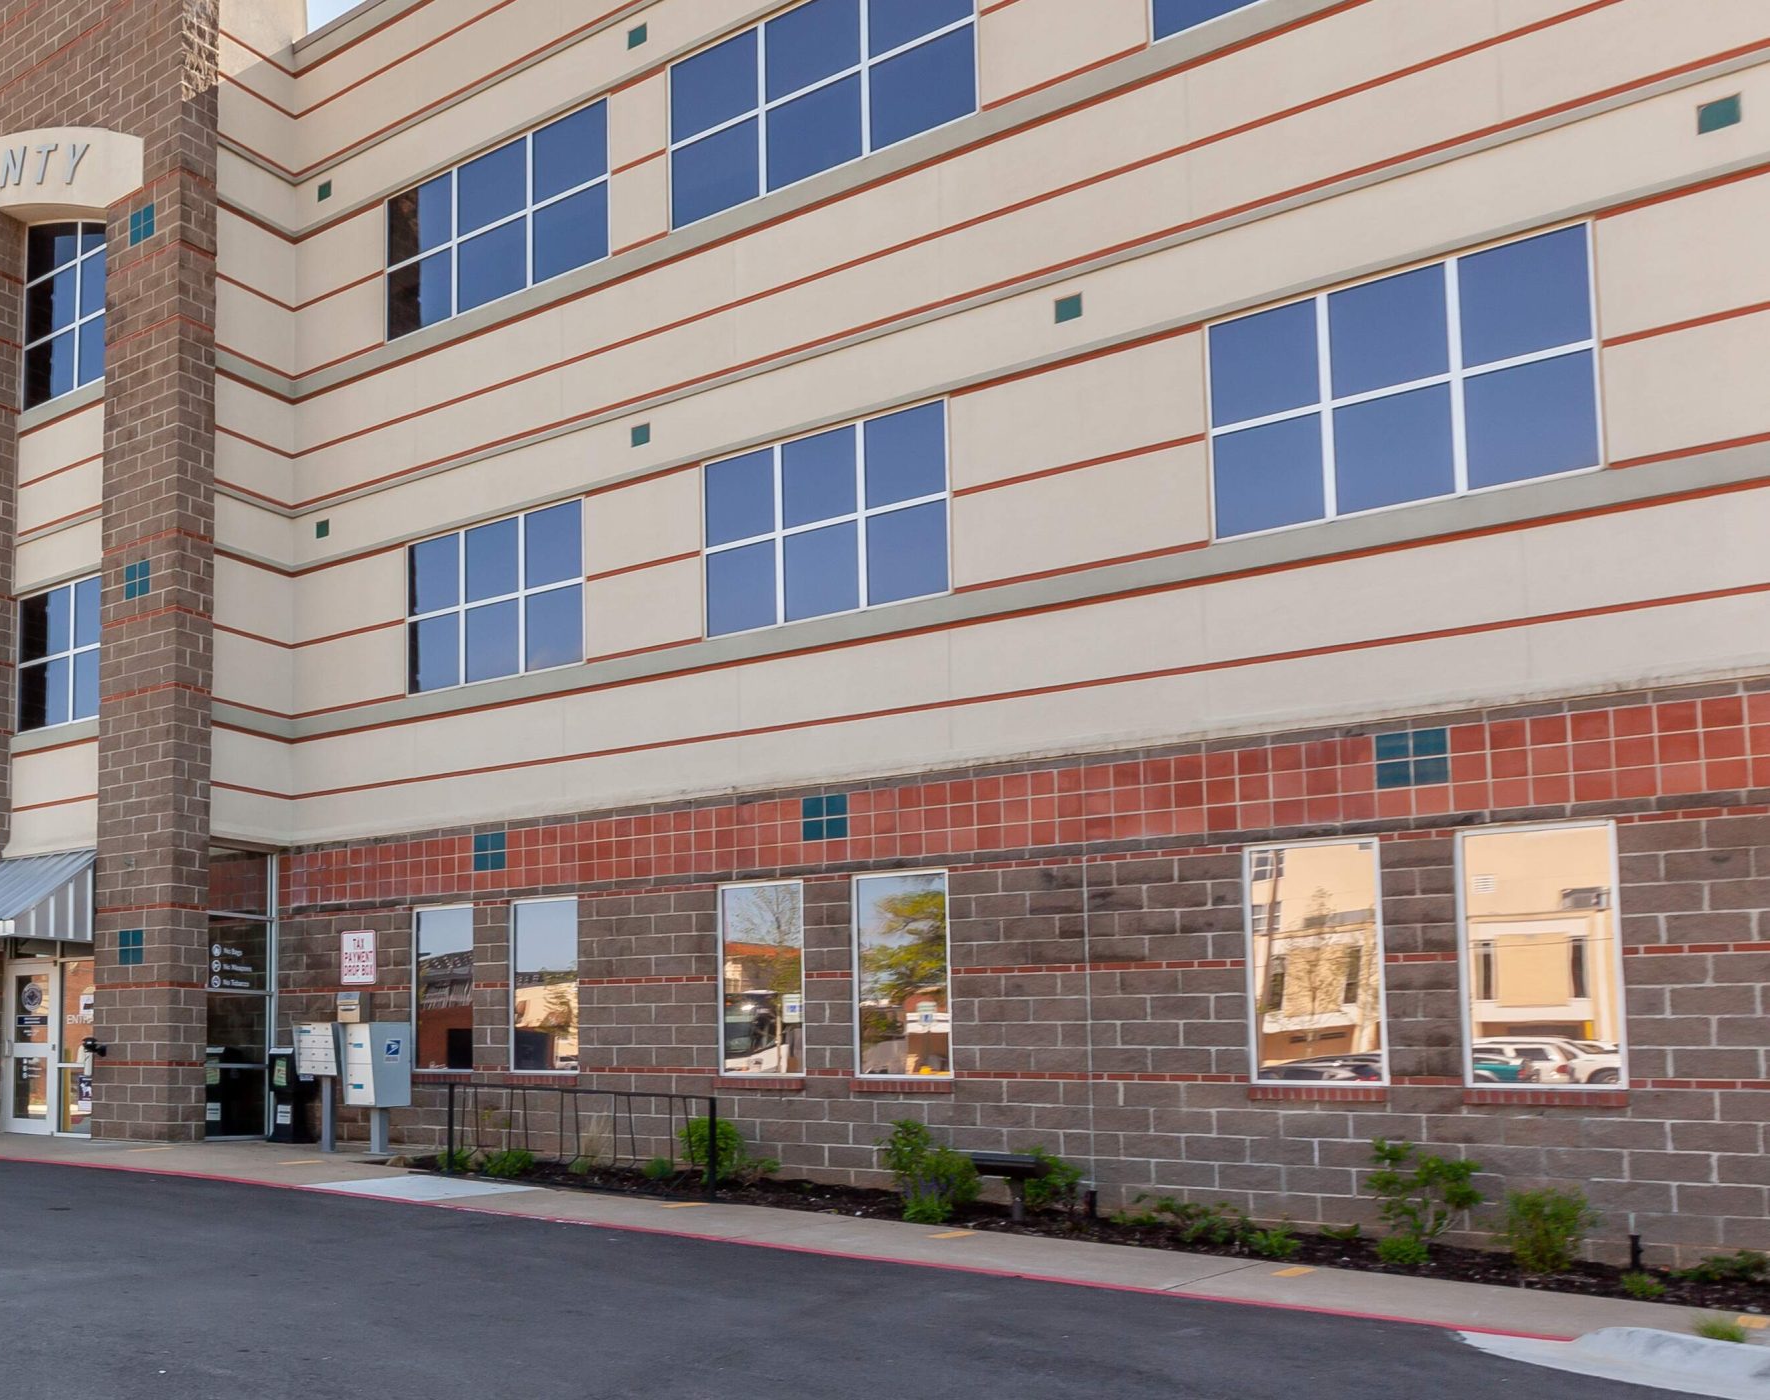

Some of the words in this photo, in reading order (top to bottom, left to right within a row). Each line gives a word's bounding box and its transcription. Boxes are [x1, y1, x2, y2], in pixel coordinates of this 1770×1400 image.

[352, 937, 365, 950] TAX
[343, 950, 374, 964] PAYMENT
[343, 964, 360, 977] DROP
[361, 964, 374, 977] BOX
